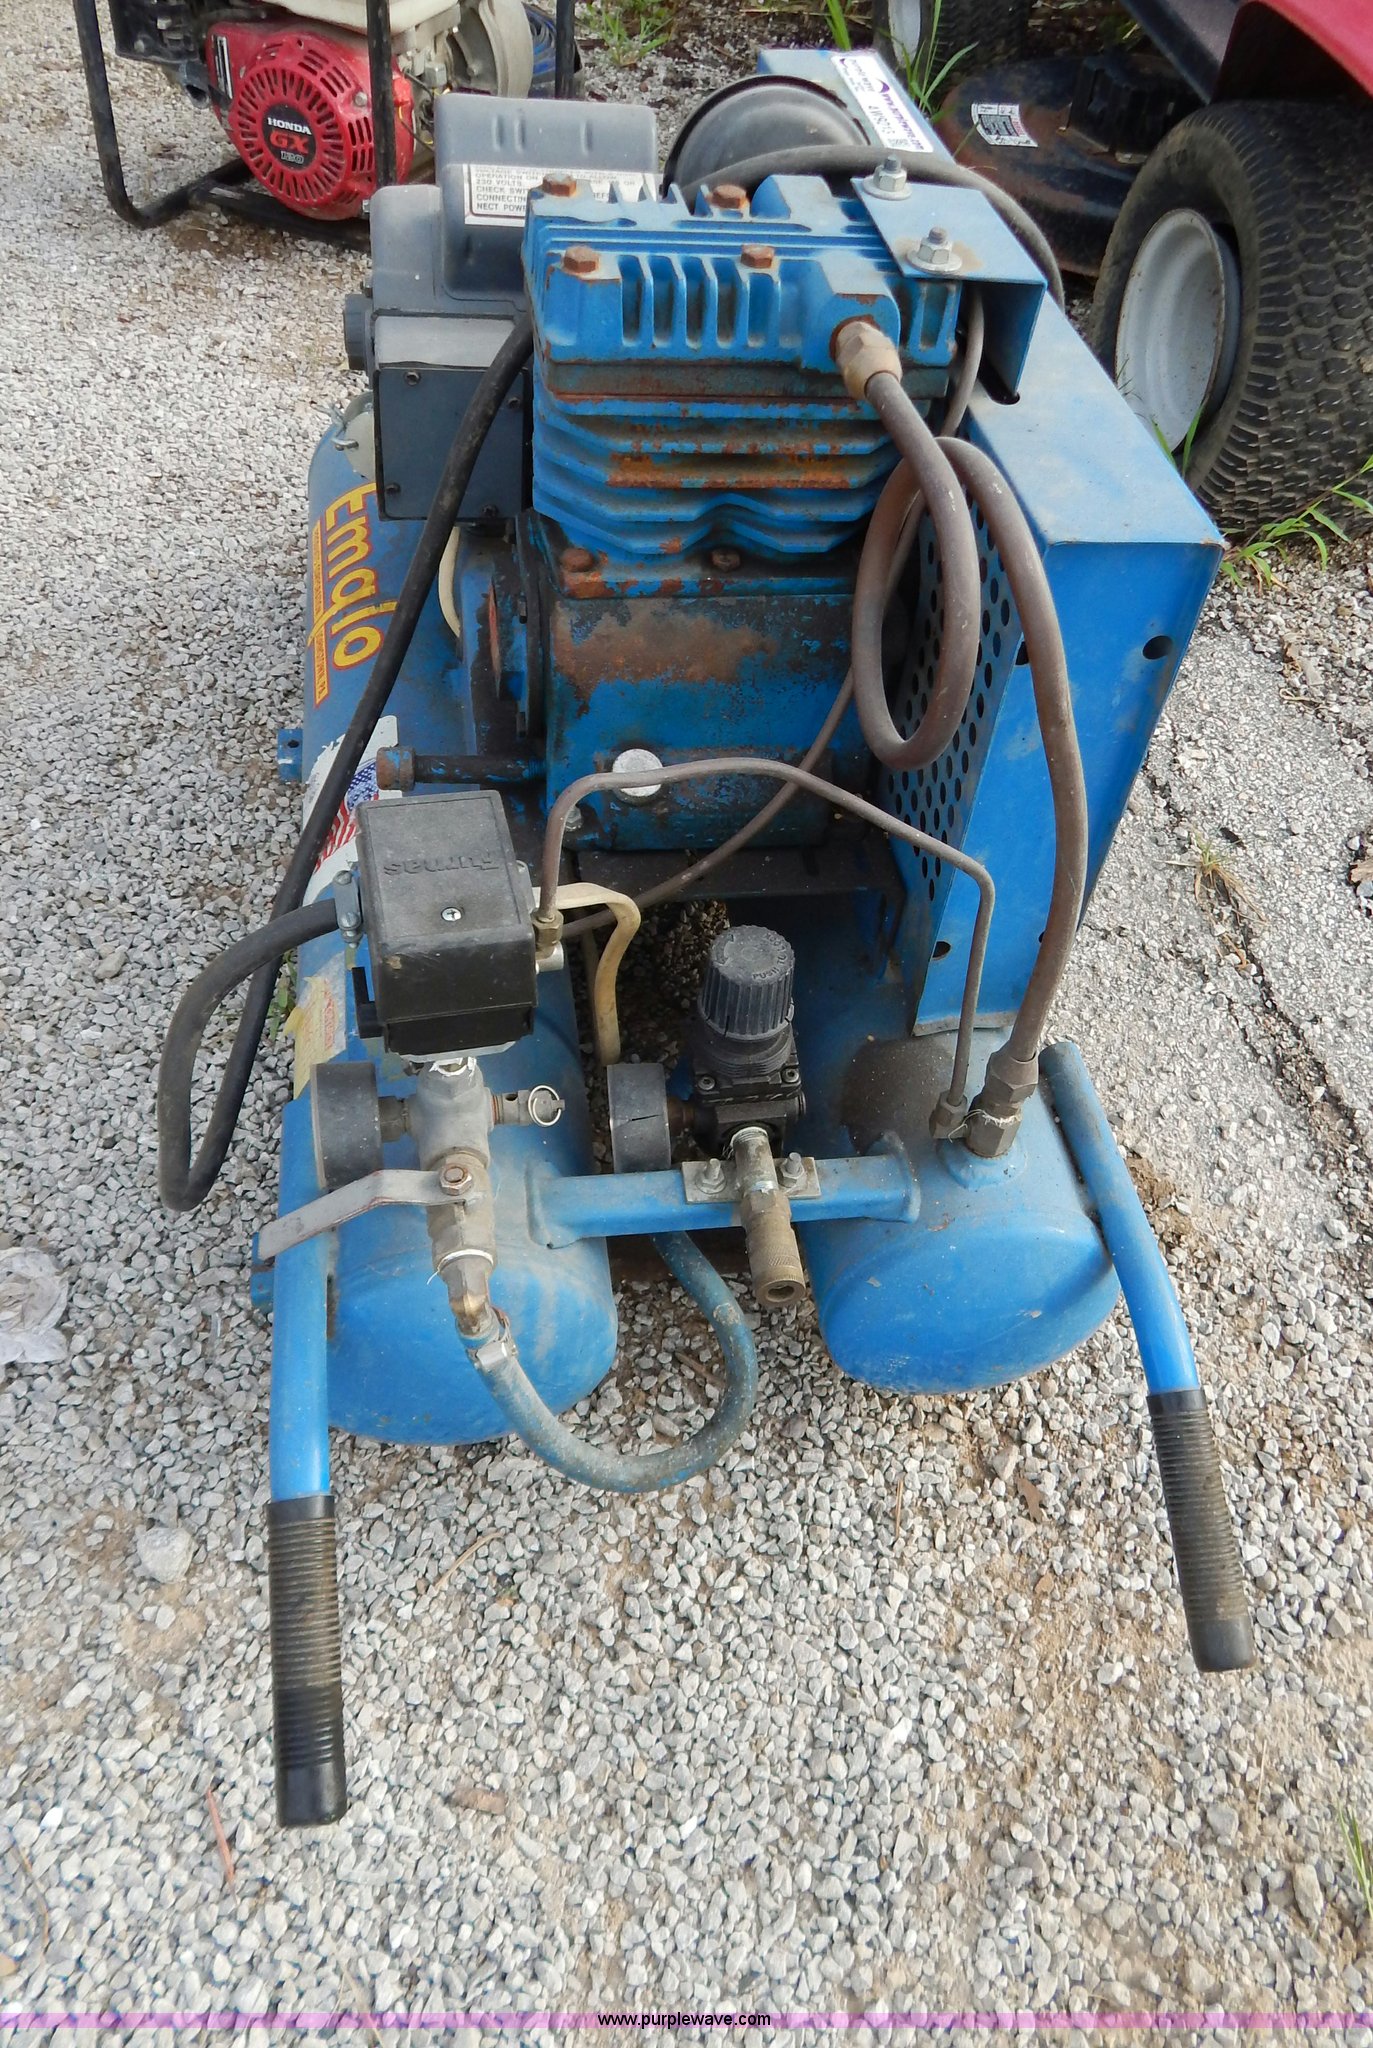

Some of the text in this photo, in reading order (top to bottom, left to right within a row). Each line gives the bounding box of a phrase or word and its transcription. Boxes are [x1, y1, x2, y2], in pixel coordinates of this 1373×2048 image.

[267, 117, 312, 135] HONDA
[270, 130, 309, 154] GX
[475, 186, 505, 194] CHECK
[476, 203, 499, 211] NECT
[751, 966, 780, 981] PUSH
